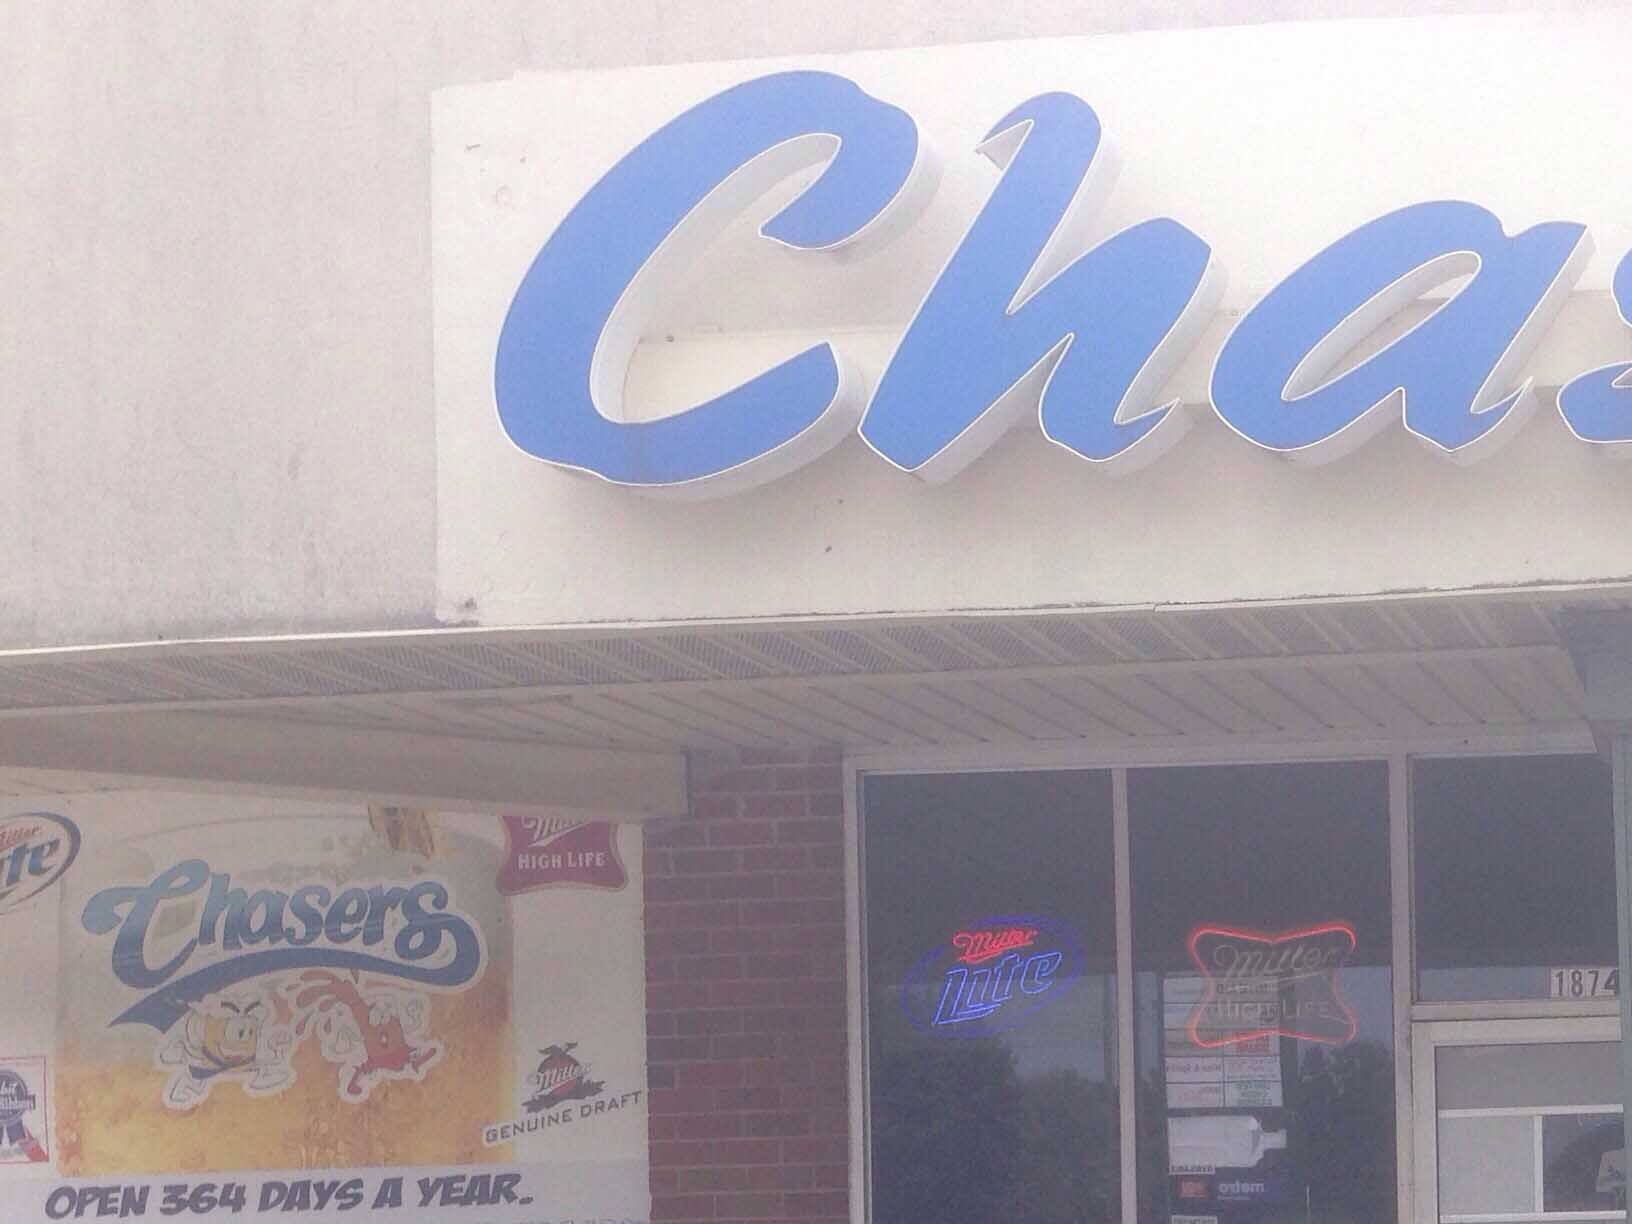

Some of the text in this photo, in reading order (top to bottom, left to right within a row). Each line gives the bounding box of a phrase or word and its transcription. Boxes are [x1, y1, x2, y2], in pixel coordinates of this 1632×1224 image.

[518, 850, 606, 870] HIGH LIFE
[81, 858, 481, 1005] Chasers
[932, 951, 1063, 1025] Lite
[1554, 969, 1617, 997] 1874
[485, 1090, 642, 1144] GENUINE DRAFT
[45, 1184, 147, 1220] OPEN
[159, 1181, 247, 1215] 364
[257, 1178, 364, 1213] DAYS
[371, 1176, 404, 1210] A
